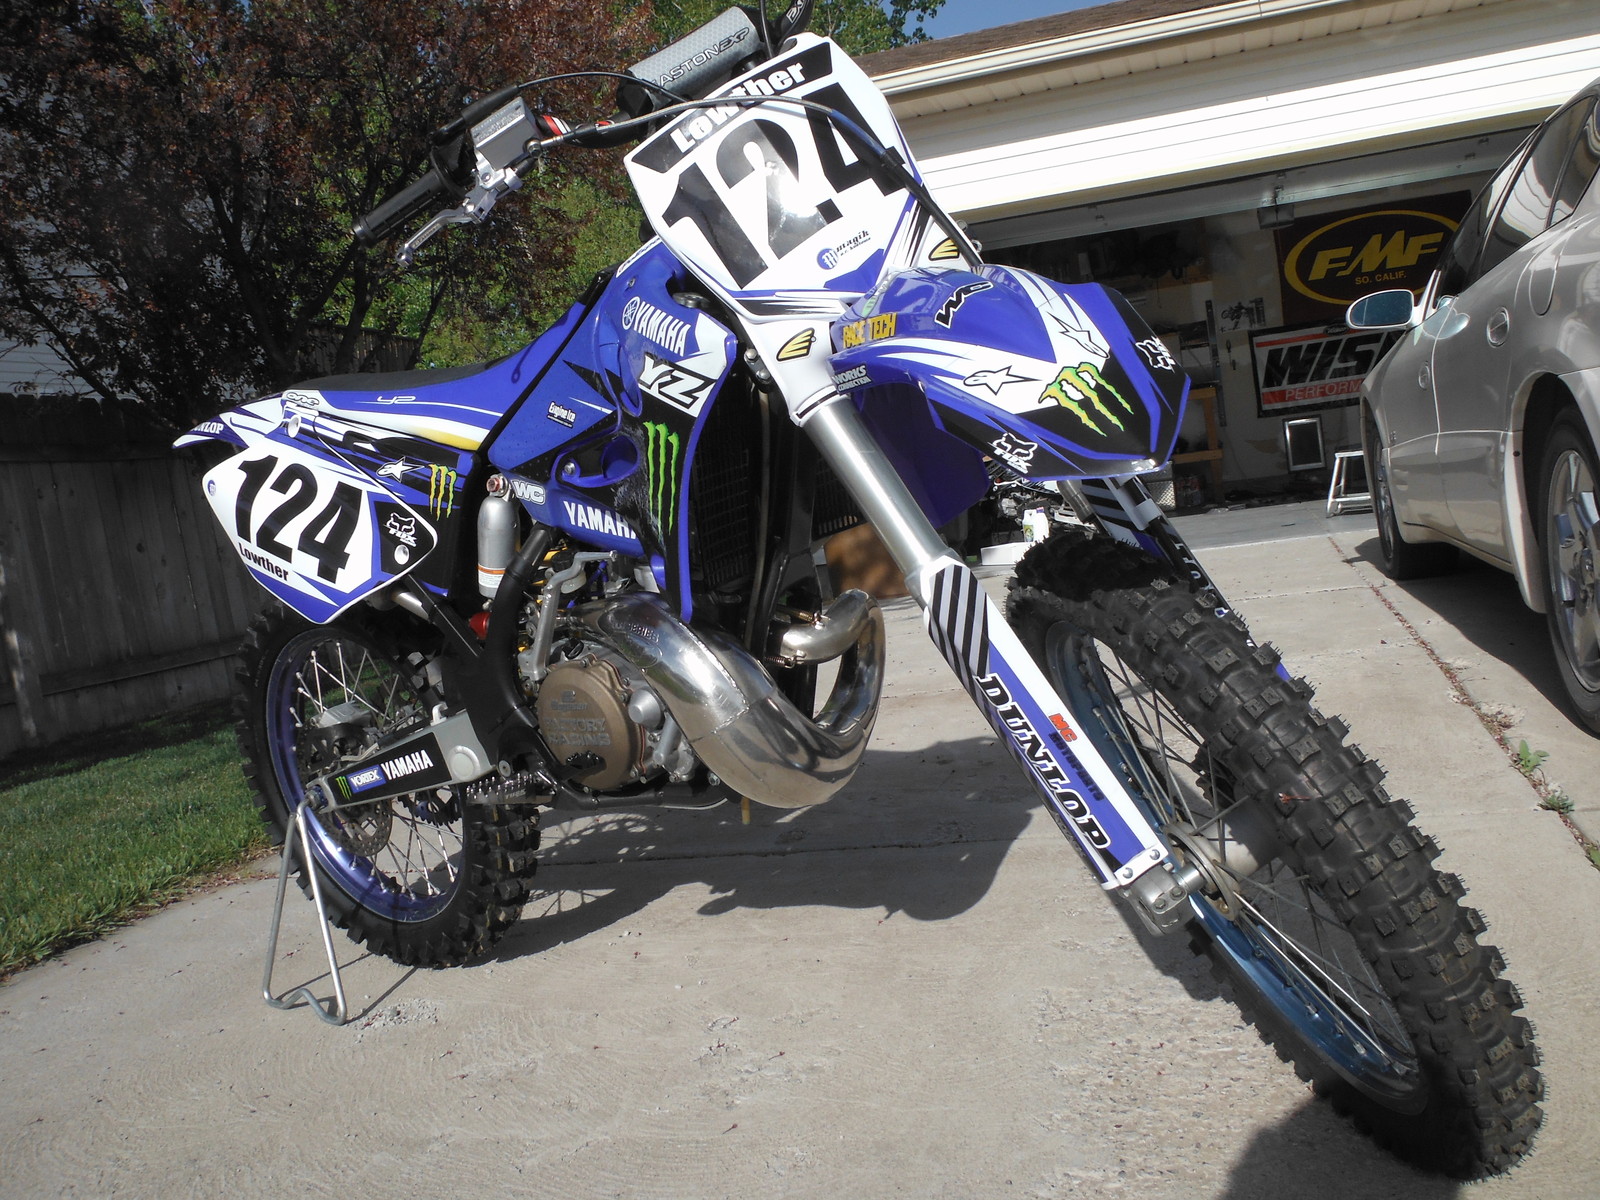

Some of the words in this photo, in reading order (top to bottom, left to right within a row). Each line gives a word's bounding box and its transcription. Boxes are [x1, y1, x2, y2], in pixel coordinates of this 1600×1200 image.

[651, 44, 719, 87] ASTON
[661, 82, 906, 290] 124
[1308, 230, 1444, 281] FMF
[1355, 276, 1372, 285] SO.
[1375, 270, 1407, 282] CALIF.
[633, 301, 691, 357] YAMAHA
[843, 320, 866, 349] RACE
[868, 312, 898, 341] TECH
[639, 352, 712, 408] YZ
[832, 365, 867, 384] WORKS
[838, 376, 872, 392] CONNECTION
[548, 402, 568, 420] Engine
[512, 480, 545, 504] WC
[235, 454, 363, 584] 124
[237, 542, 289, 581] Lowther
[350, 769, 381, 788] VORTEX
[380, 749, 434, 780] YAMAHA
[972, 673, 1111, 850] DUNLOP
